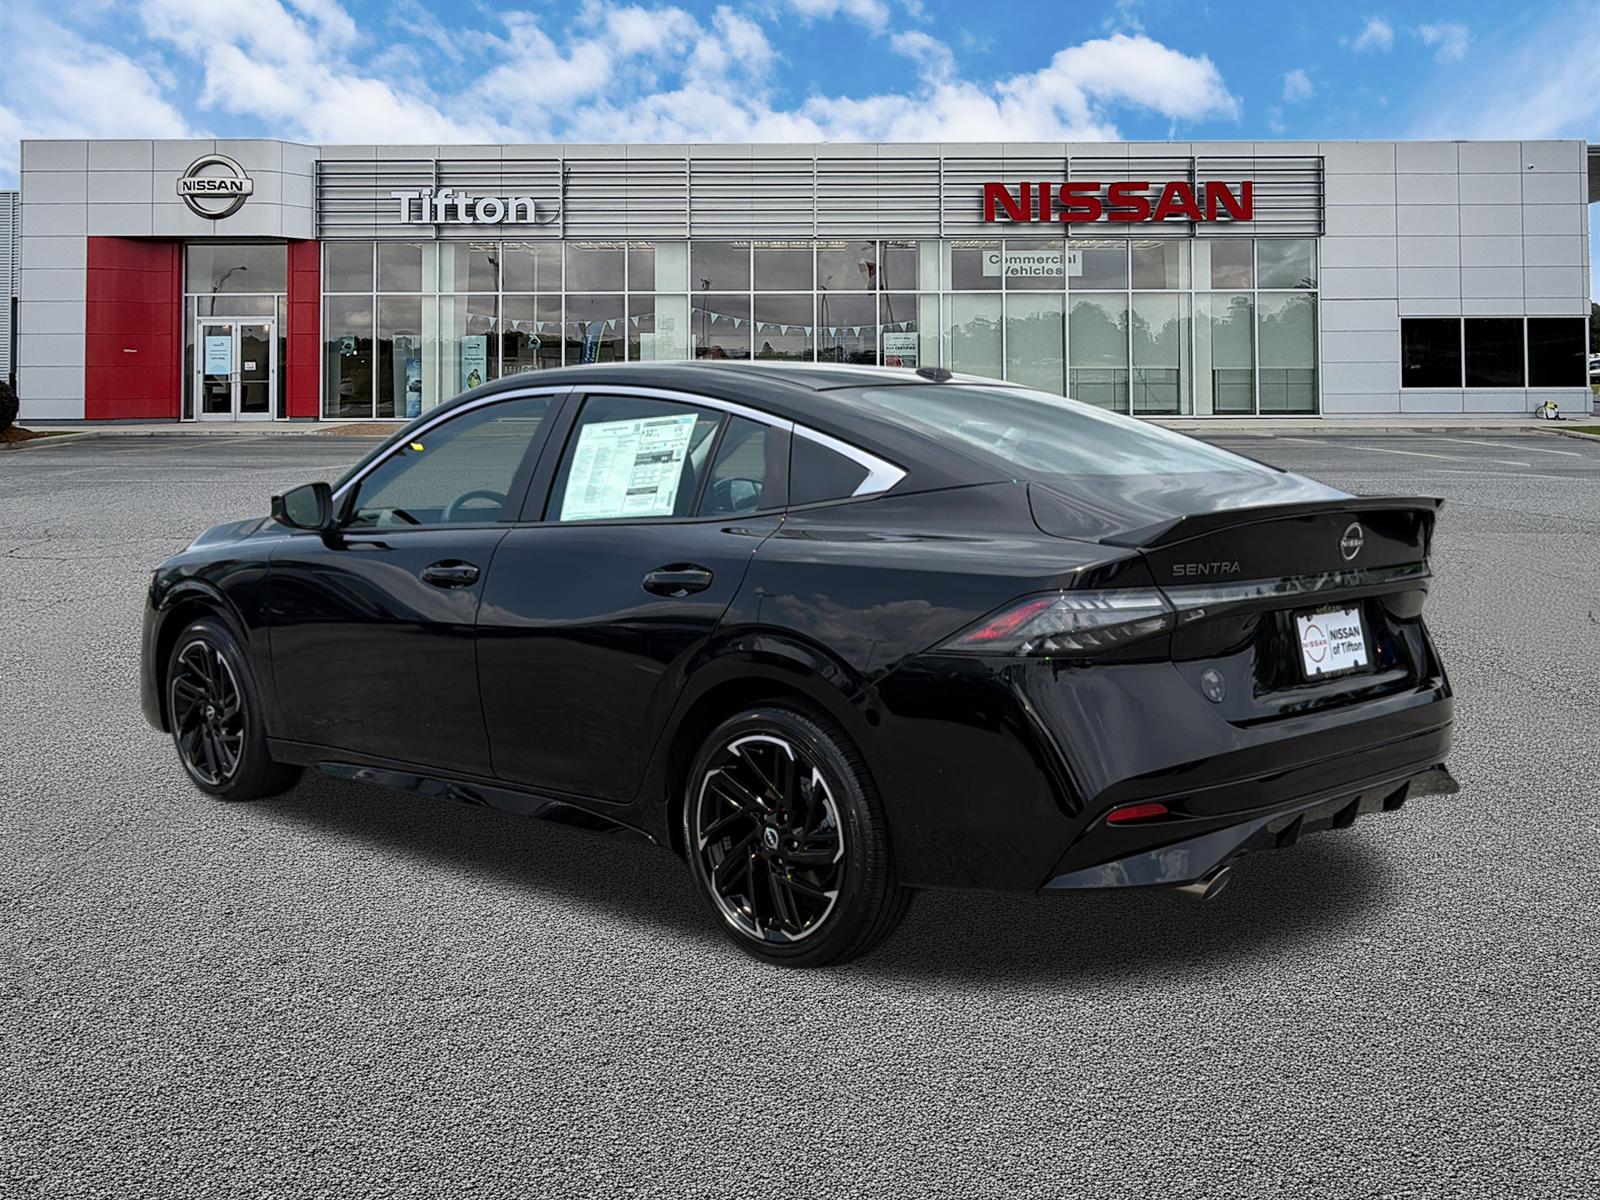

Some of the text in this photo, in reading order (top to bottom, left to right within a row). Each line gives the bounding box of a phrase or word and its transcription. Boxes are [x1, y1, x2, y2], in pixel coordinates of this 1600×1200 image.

[183, 181, 243, 191] NISSAN
[391, 188, 536, 224] Tifton
[984, 181, 1253, 222] NISSAN
[1172, 562, 1241, 576] SENTRA
[1330, 627, 1360, 640] NISSAN
[1303, 640, 1327, 648] NISSAN
[1341, 642, 1363, 654] Tifton
